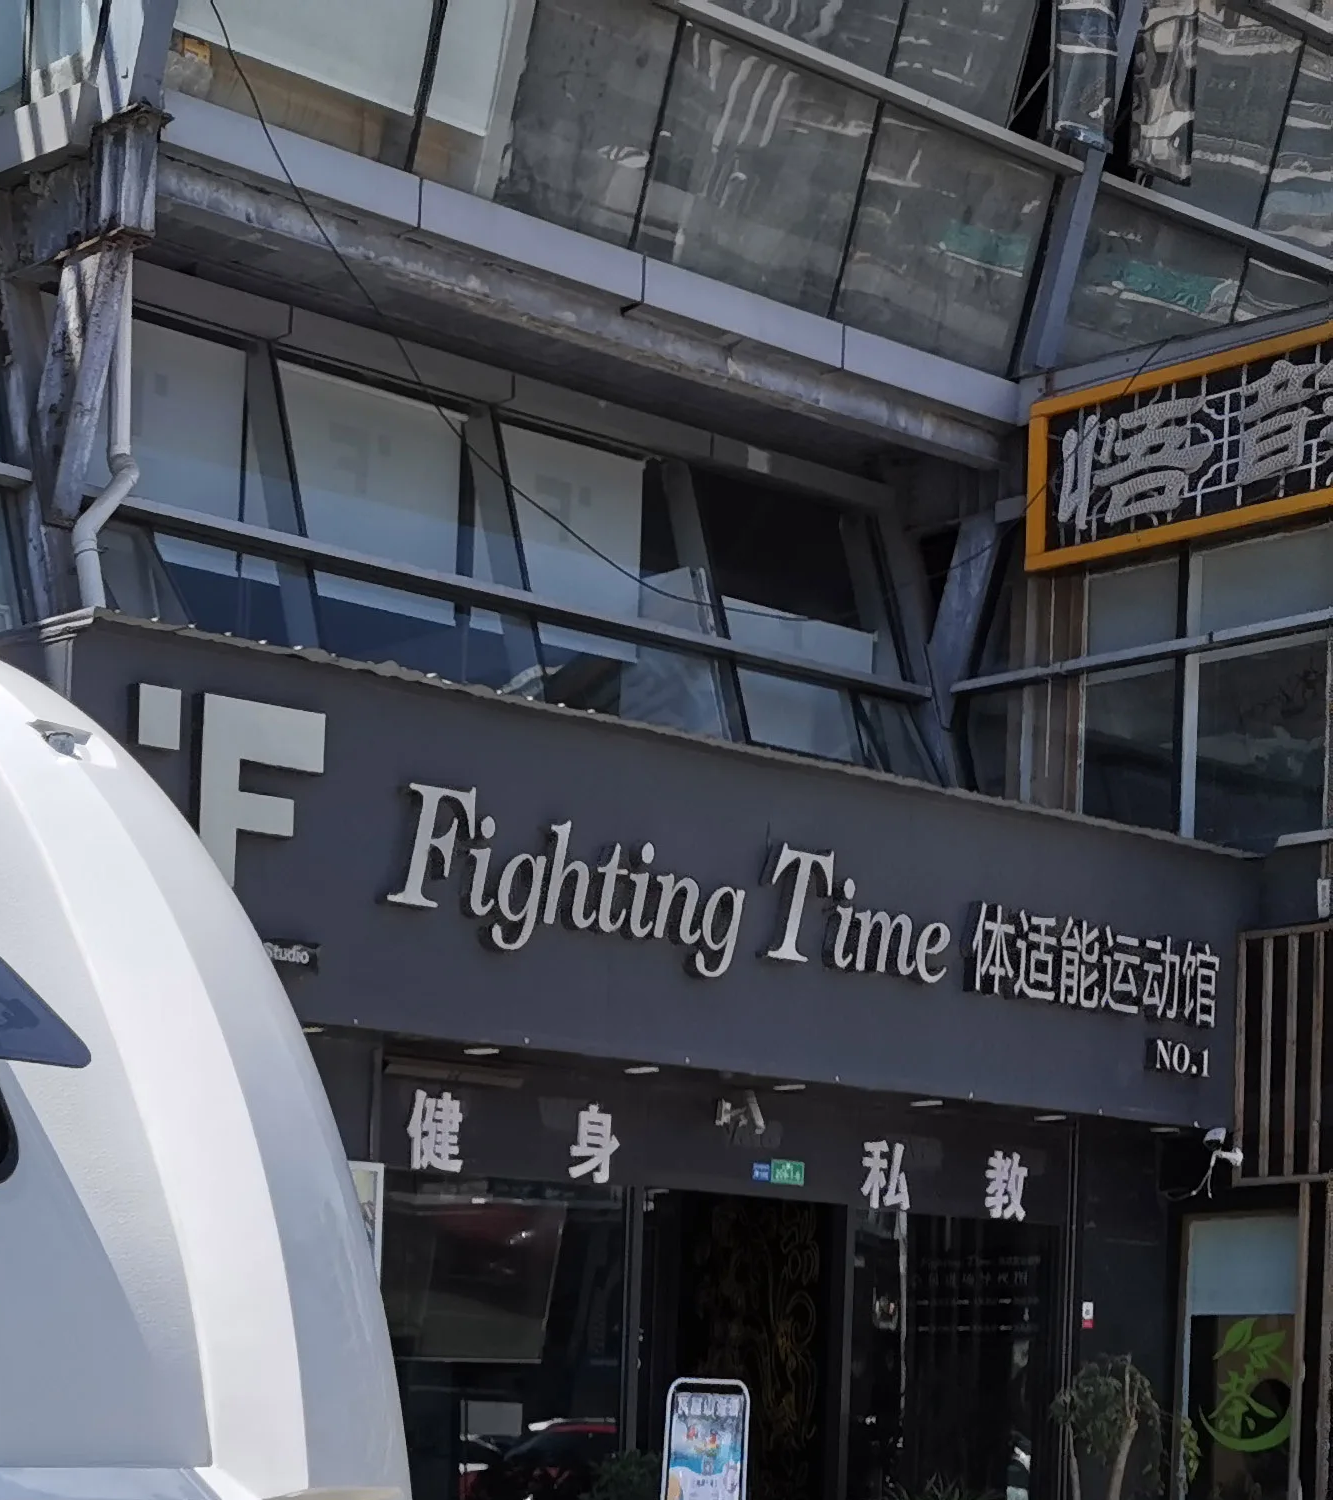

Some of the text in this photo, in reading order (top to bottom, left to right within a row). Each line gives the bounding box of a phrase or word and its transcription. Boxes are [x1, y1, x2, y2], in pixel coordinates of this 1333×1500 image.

[386, 782, 952, 984] Fighting Time
[262, 941, 310, 965] Studio
[970, 900, 1221, 1029] 体适能运动馆
[1154, 1038, 1211, 1078] NO.1
[405, 1088, 1029, 1221] 健身 私教
